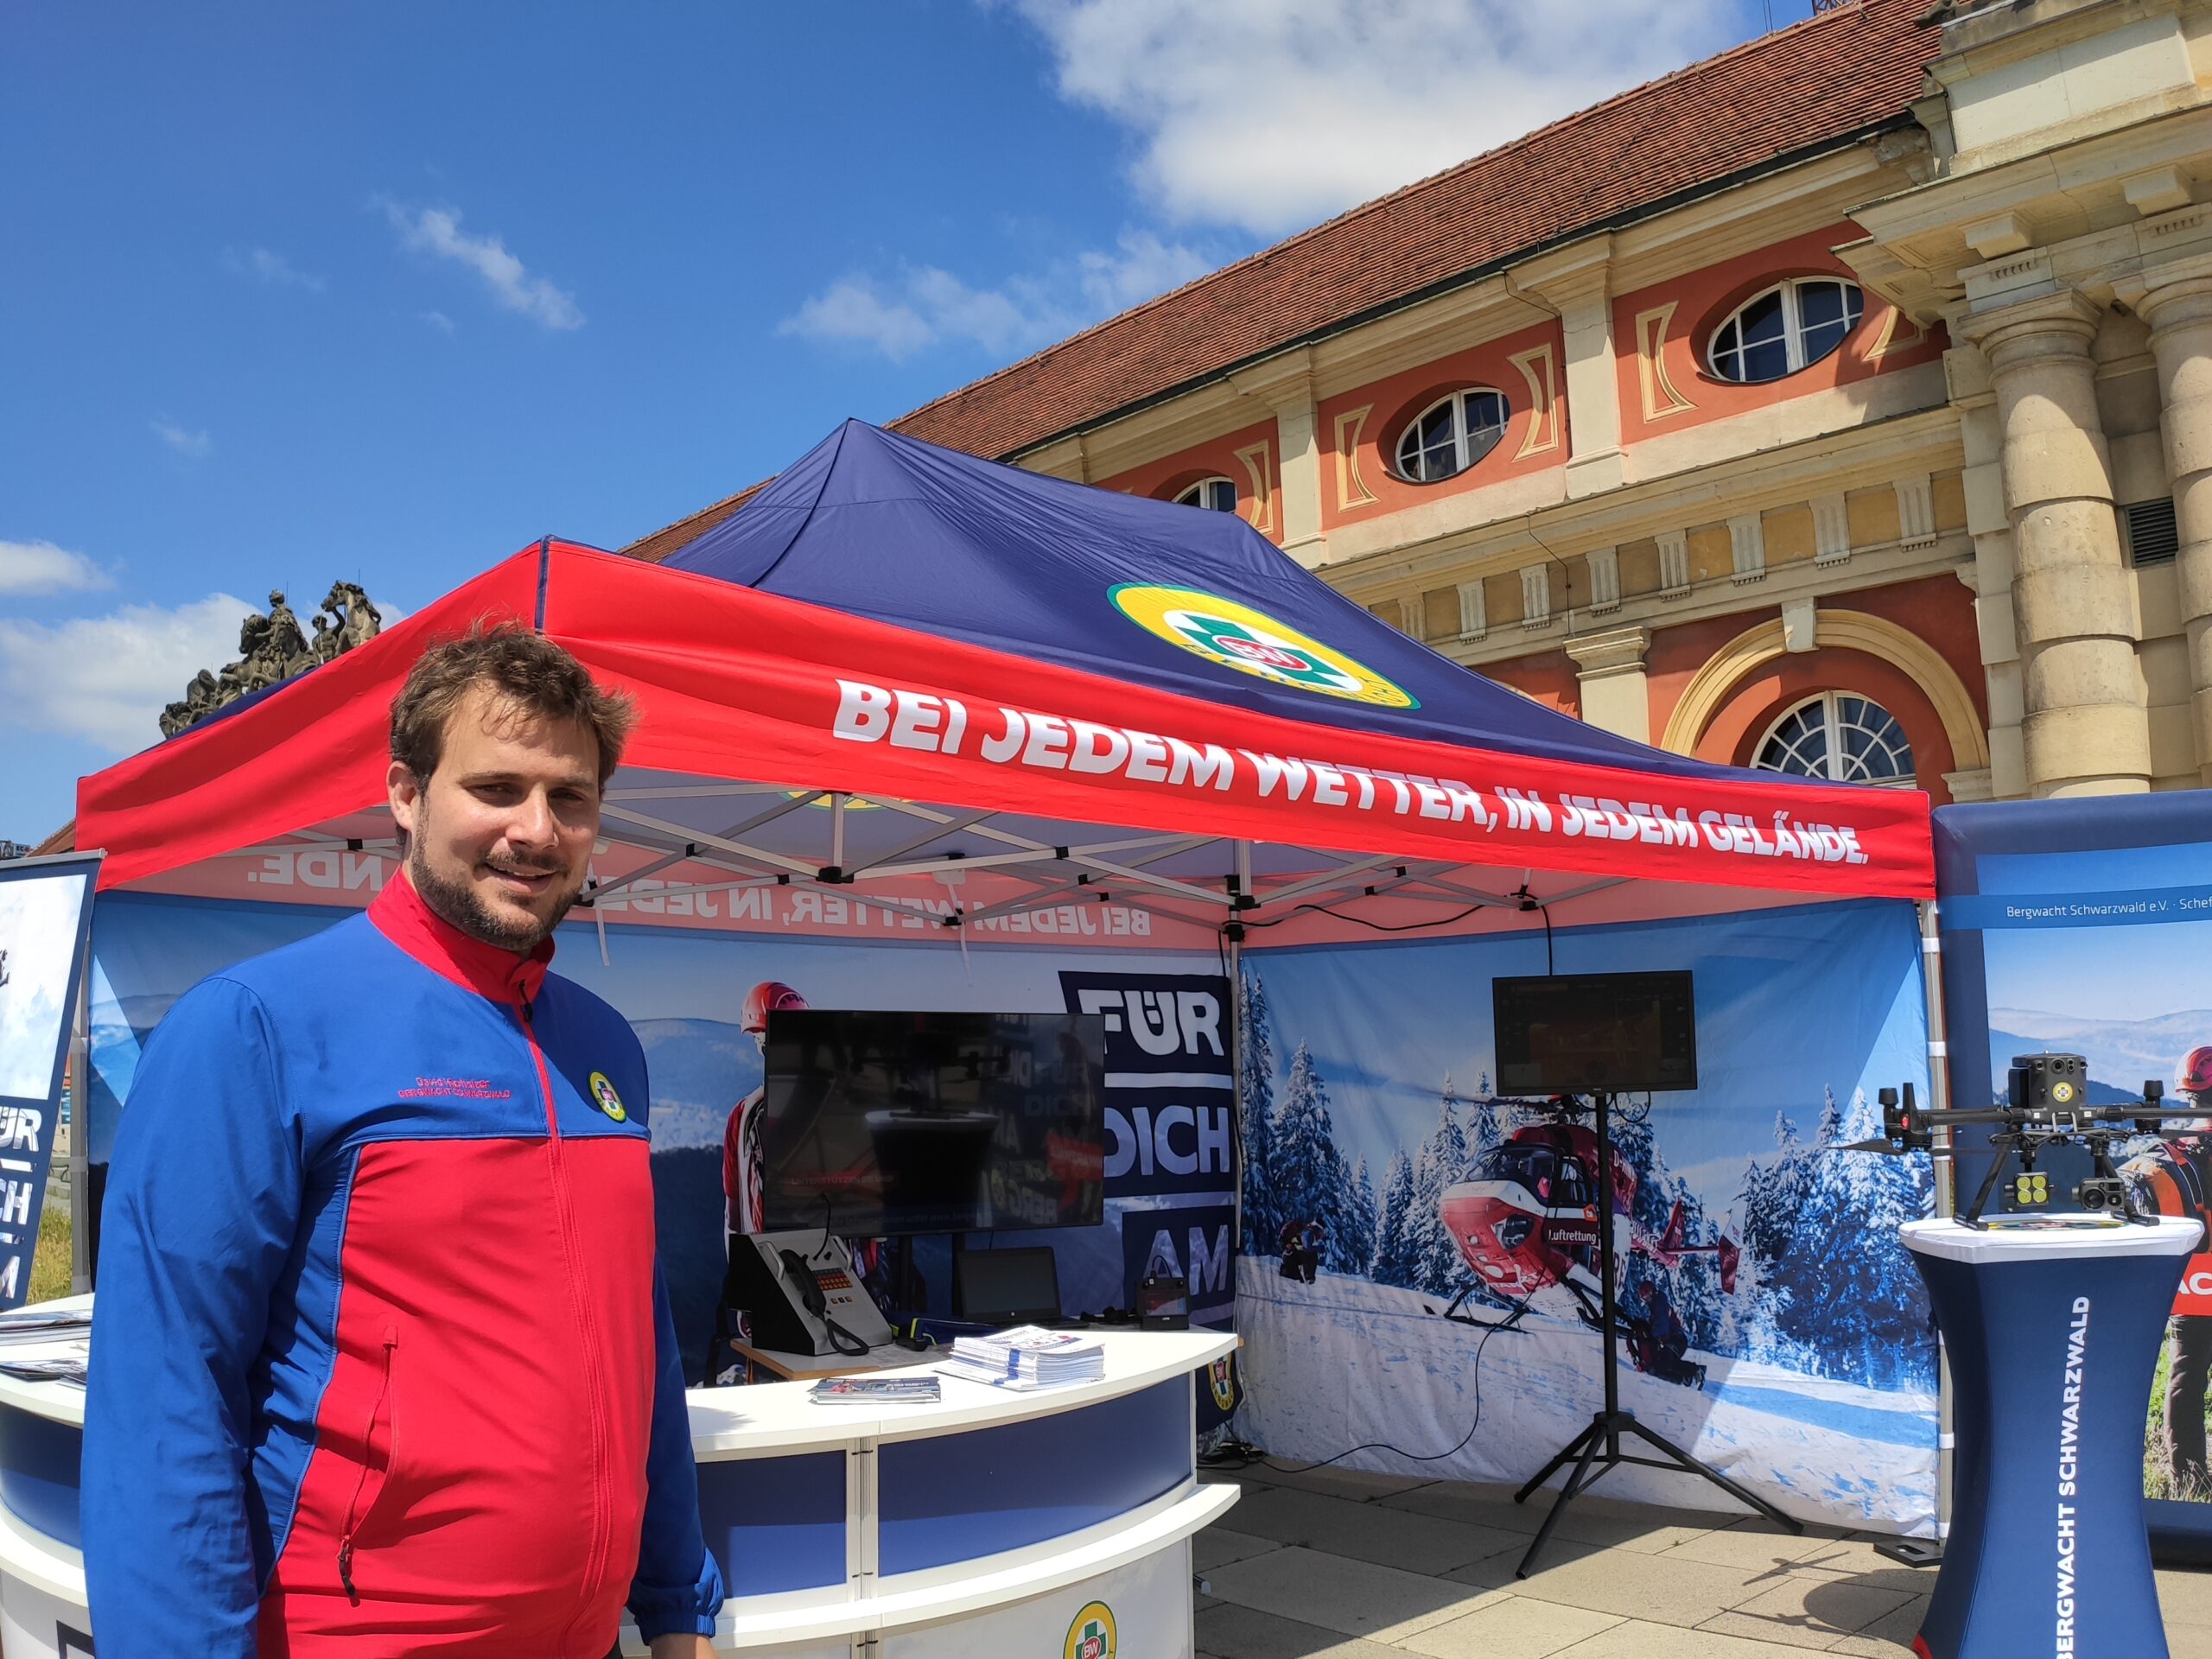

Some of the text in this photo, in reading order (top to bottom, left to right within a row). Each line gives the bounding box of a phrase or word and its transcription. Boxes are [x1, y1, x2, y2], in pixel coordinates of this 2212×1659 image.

[1220, 639, 1299, 666] BW
[832, 678, 1870, 865] BEI JEDEM WETTER, IN JEDEM GELÄNDE.
[2006, 904, 2068, 920] Bergwacht
[2070, 900, 2146, 917] Schwarzwald
[2149, 899, 2170, 912] e.V.
[1077, 988, 1225, 1056] FÜR
[1103, 1104, 1230, 1179] DICH
[1142, 1224, 1229, 1296] AM
[1548, 1228, 1598, 1246] Luftrettung
[2058, 1296, 2090, 1497] SCHWARZWALD
[1084, 1640, 1099, 1659] BW
